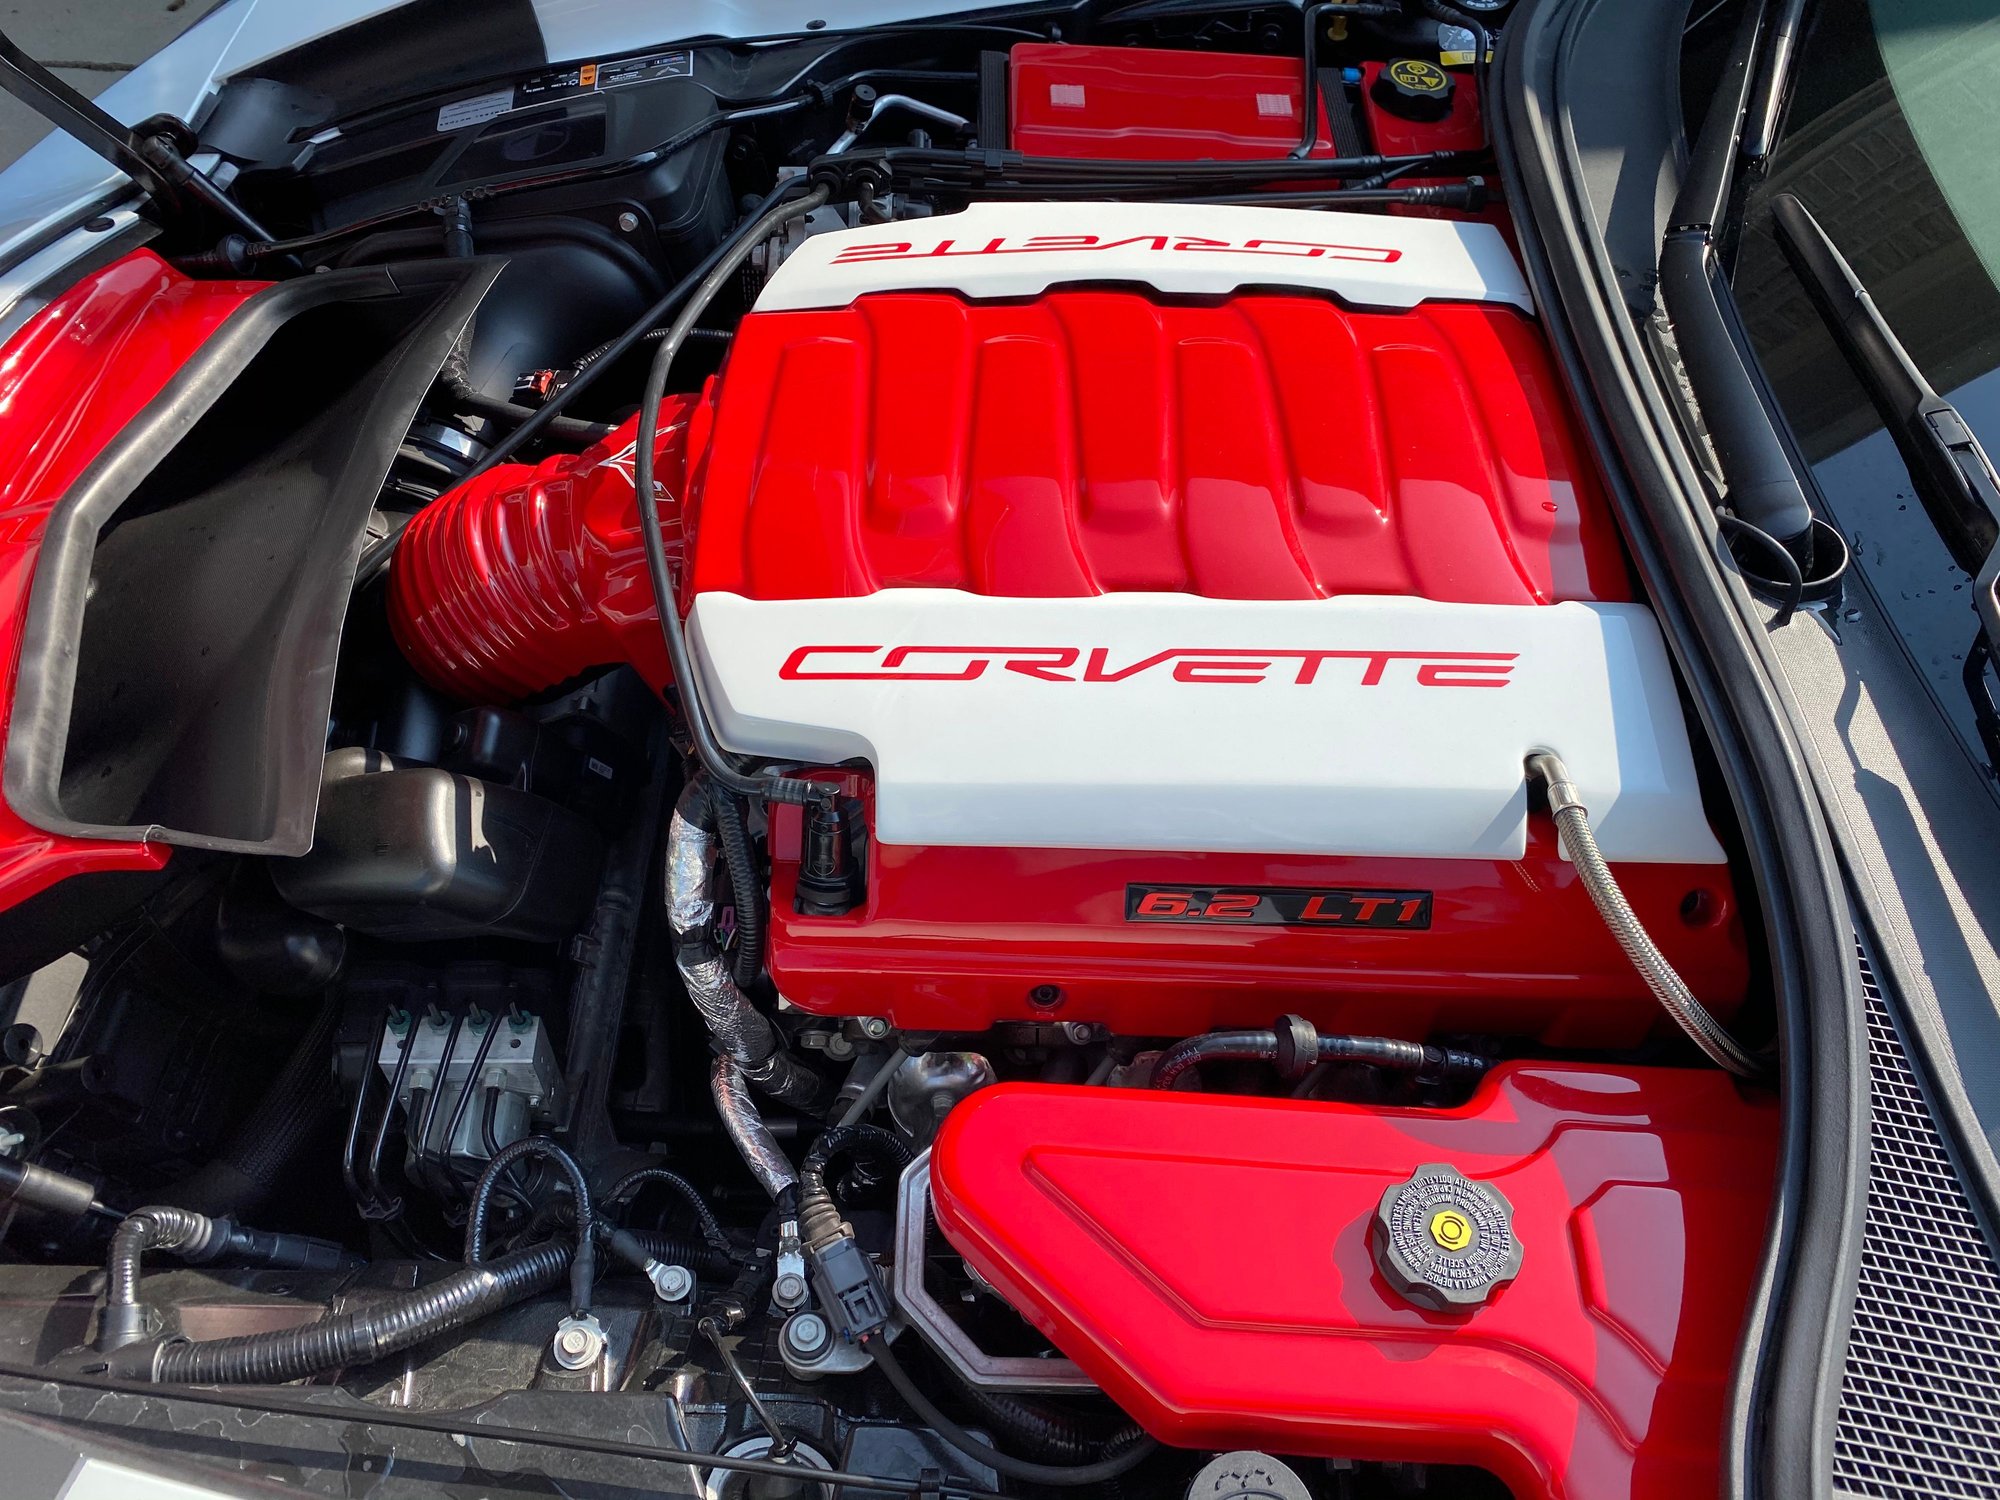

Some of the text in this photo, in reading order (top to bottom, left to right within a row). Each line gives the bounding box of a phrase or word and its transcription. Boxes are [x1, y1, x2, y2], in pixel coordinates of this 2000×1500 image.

[830, 235, 1402, 264] CORVETTE
[778, 645, 1520, 687] CORVETTE
[1137, 893, 1422, 922] 6.2 LT1
[1174, 1046, 1200, 1061] TYPE
[1414, 1176, 1434, 1189] FLUID
[1440, 1184, 1453, 1193] CAP
[1399, 1184, 1416, 1201] FROM
[1414, 1185, 1438, 1201] BEFORE
[1392, 1205, 1403, 1231] SEALED
[1413, 1210, 1424, 1231] CLEAN
[1455, 1197, 1489, 1230] PROVENANT
[1491, 1204, 1510, 1239] NETTOYER
[1489, 1220, 1499, 1234] QUE
[1404, 1233, 1416, 1248] USE
[1416, 1232, 1434, 1257] FILLER
[1491, 1235, 1500, 1245] DU
[1502, 1240, 1511, 1250] LE
[1412, 1246, 1430, 1264] ONLY
[1437, 1255, 1465, 1267] SCELLE
[1464, 1248, 1485, 1265] BIDON
[1480, 1246, 1498, 1270] LIQUIDE
[1471, 1264, 1482, 1275] DE
[1486, 1250, 1509, 1278] BOUCHON
[1424, 1268, 1452, 1287] DEPOSE
[1450, 1268, 1471, 1278] FREIN
[1467, 1274, 1488, 1288] AVANT
[1454, 1279, 1465, 1289] LA
